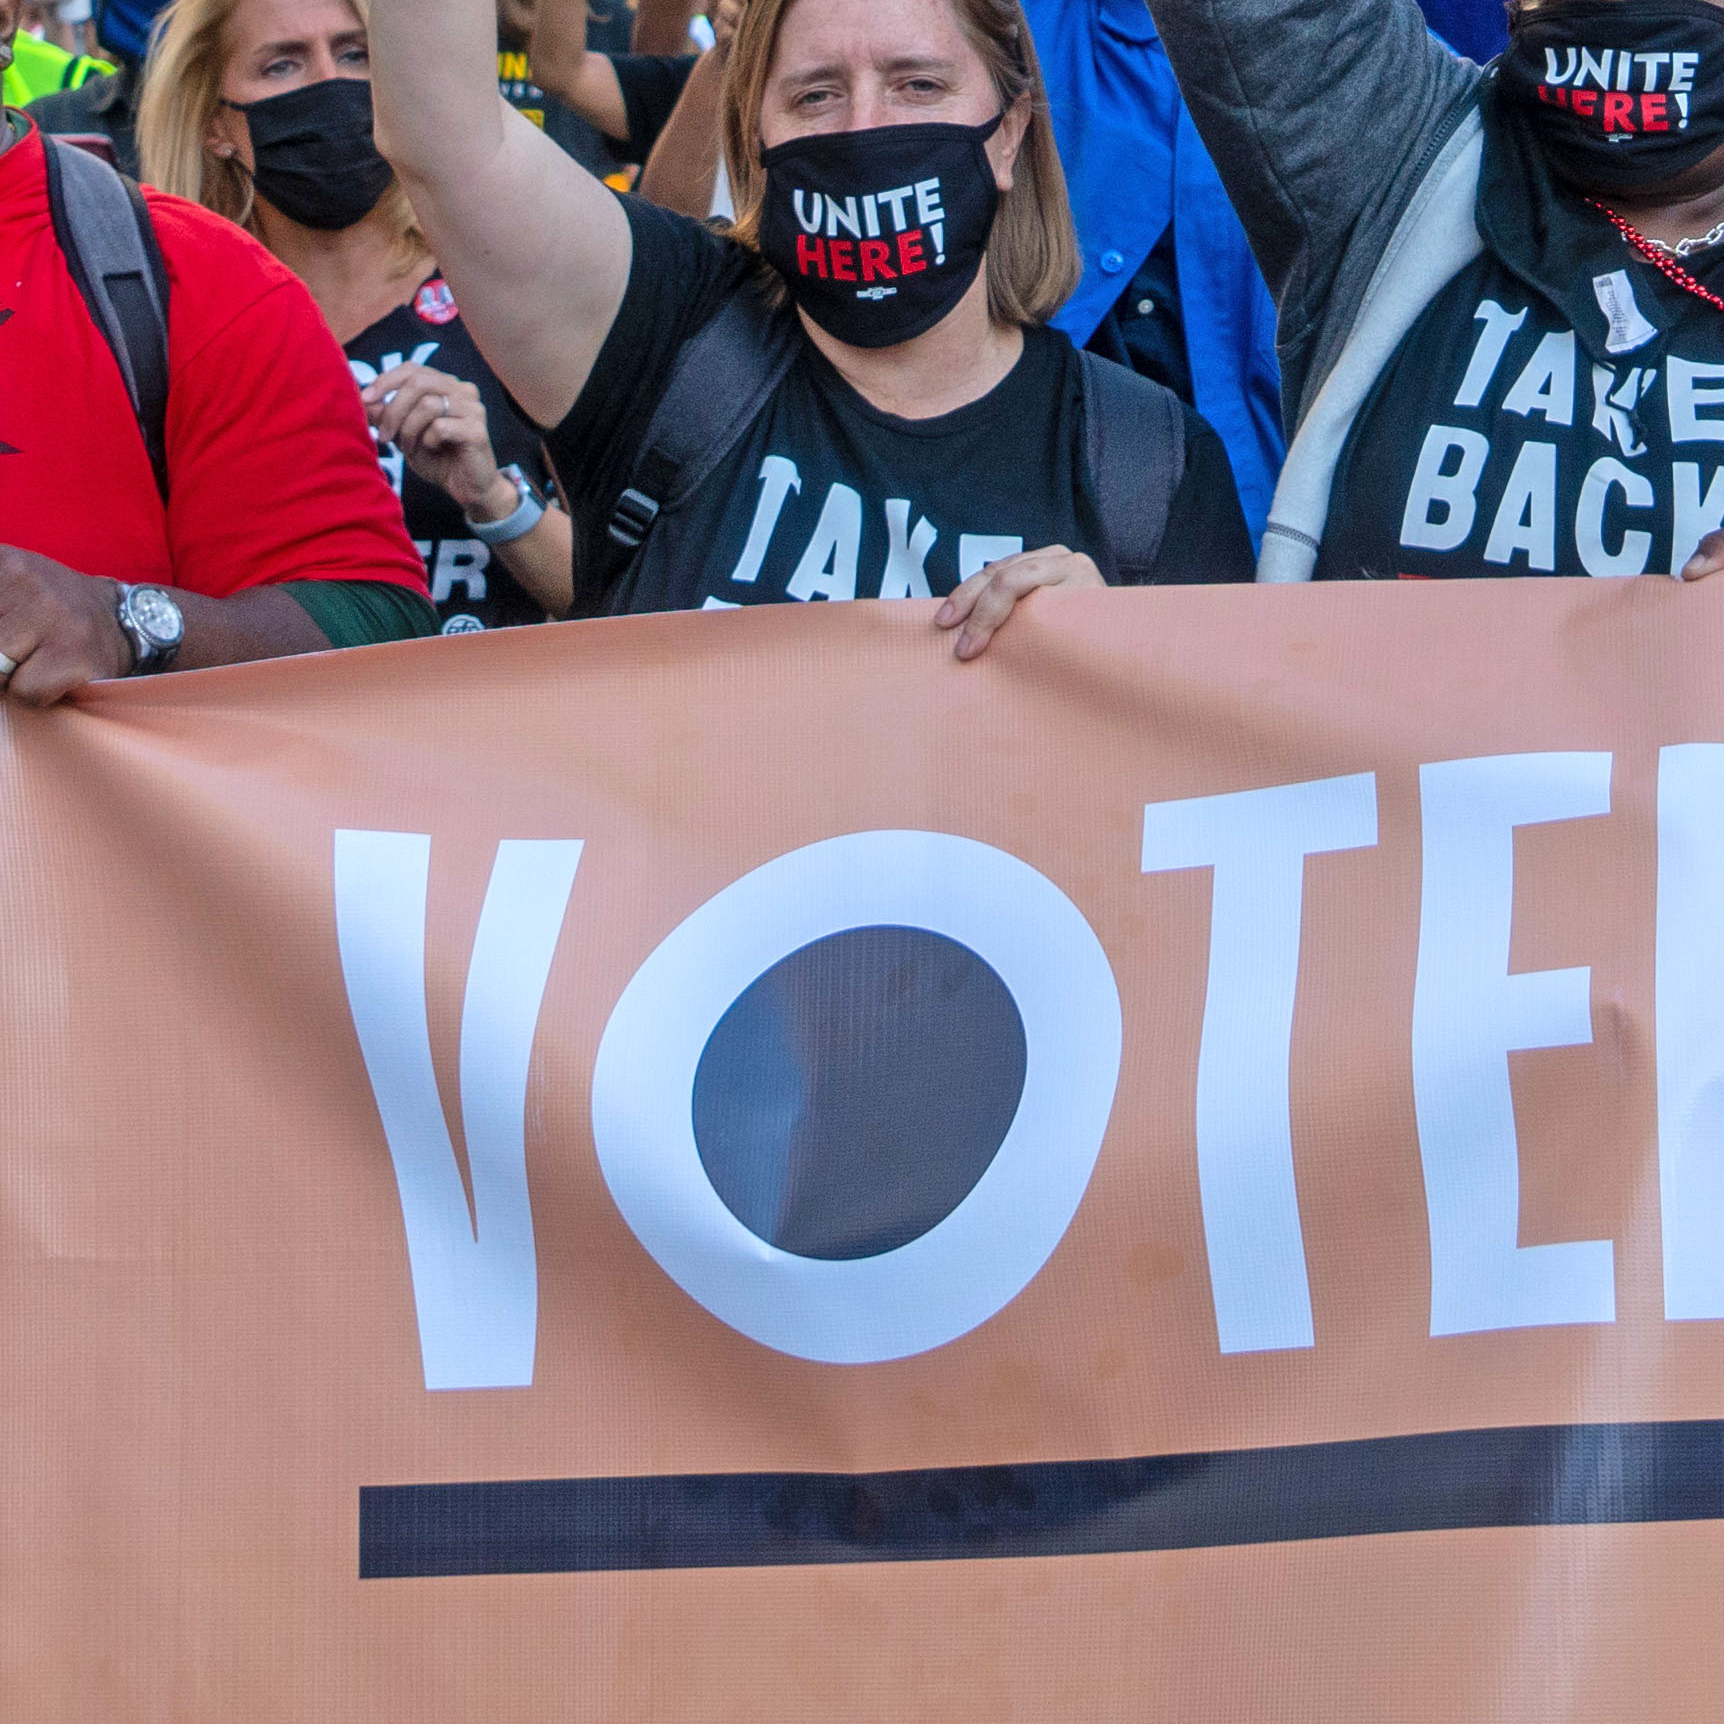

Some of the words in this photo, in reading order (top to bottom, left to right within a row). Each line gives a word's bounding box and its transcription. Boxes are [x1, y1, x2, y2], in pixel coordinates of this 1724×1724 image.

[1545, 46, 1699, 92] UNITE
[793, 176, 946, 242] UNITE
[797, 221, 946, 284] HERE!
